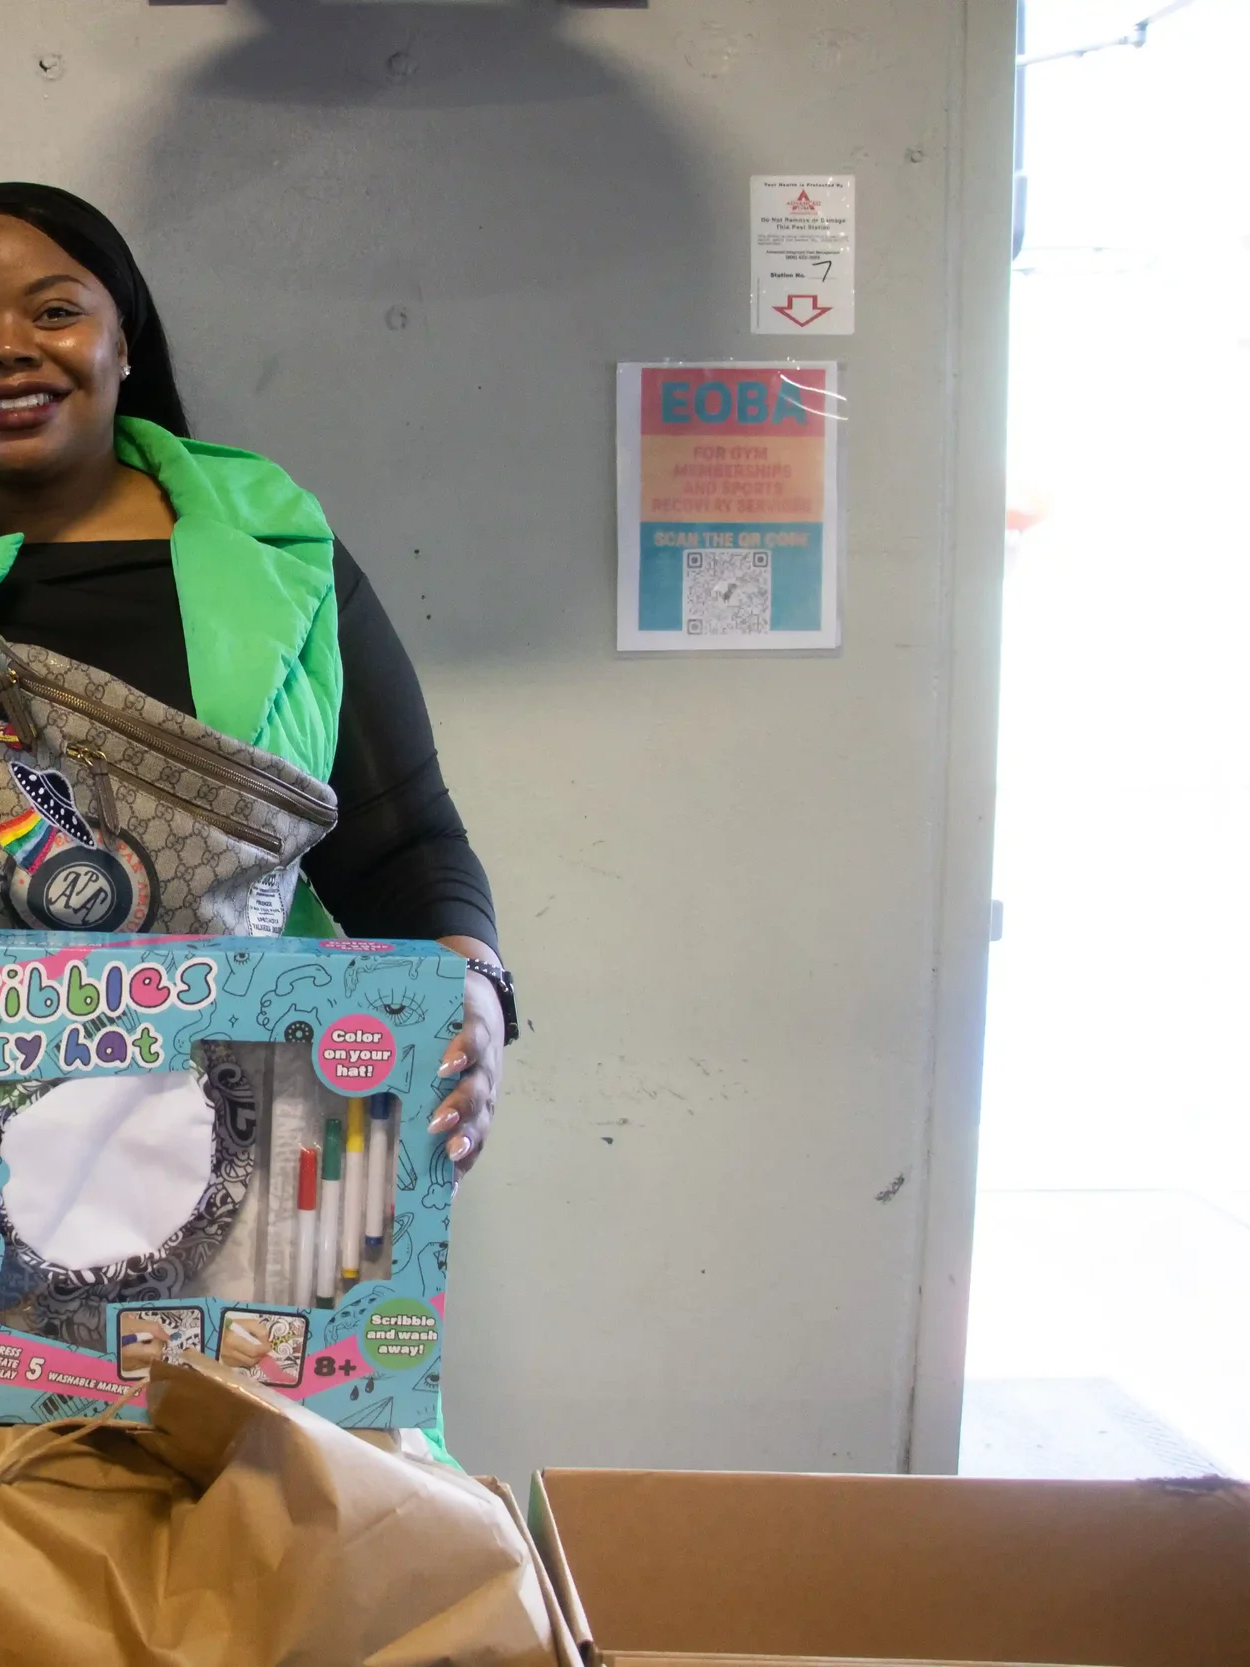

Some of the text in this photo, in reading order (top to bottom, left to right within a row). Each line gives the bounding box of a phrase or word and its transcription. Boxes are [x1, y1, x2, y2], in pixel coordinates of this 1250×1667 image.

[812, 260, 832, 282] 7
[661, 381, 809, 425] EOBA
[694, 446, 768, 459] FOR GYM
[673, 464, 792, 478] MEMBERSHIPS
[683, 482, 784, 495] AND SPORTS
[654, 532, 810, 547] SCAN THE QR CODE
[332, 1030, 382, 1044] Color
[61, 1024, 163, 1070] hat
[323, 1049, 392, 1064] on your
[336, 1064, 374, 1078] hat!
[370, 1314, 436, 1326] Scribble
[366, 1329, 438, 1341] and wash
[377, 1344, 425, 1356] away!
[314, 1356, 357, 1377] 8+
[25, 1357, 142, 1398] 5 WASHABLE MARKES
